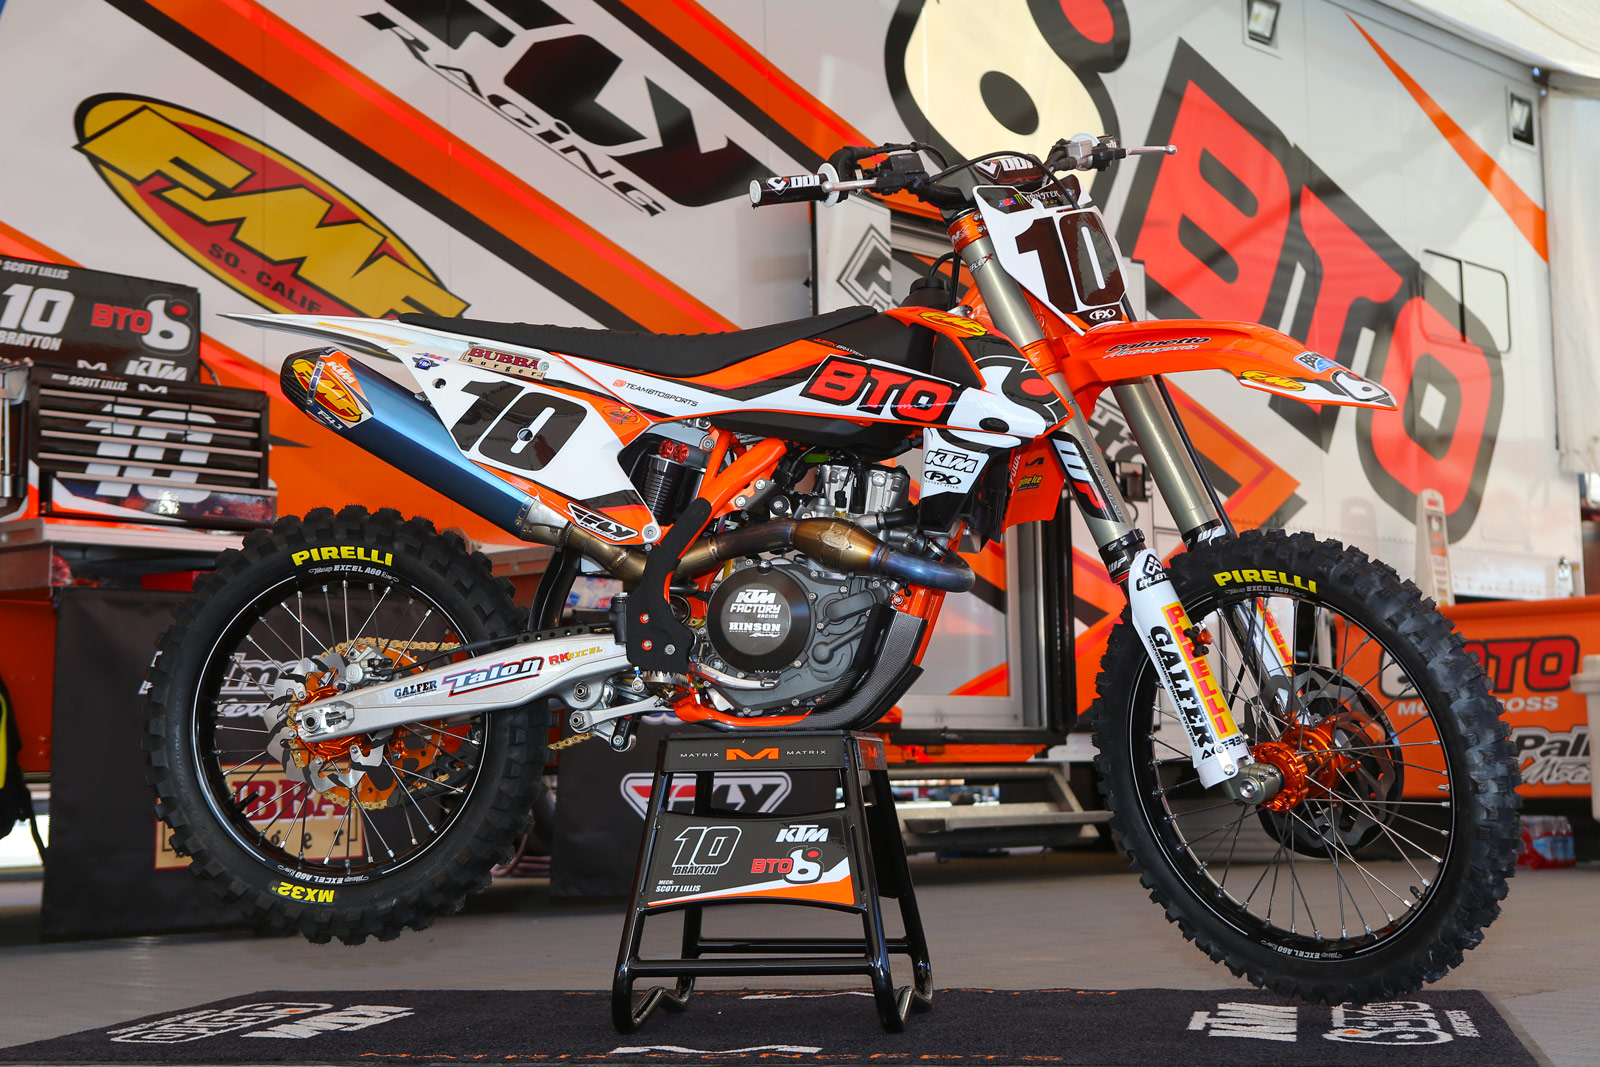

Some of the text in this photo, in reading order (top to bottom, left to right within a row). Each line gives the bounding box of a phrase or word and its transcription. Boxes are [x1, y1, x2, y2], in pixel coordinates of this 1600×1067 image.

[359, 12, 666, 217] RACING
[3, 260, 70, 280] SCOTT LILLIS
[1018, 211, 1127, 314] 10
[1, 283, 75, 335] 10
[91, 303, 152, 334] BTO
[1090, 307, 1116, 320] FX
[921, 311, 987, 335] FMF
[125, 356, 187, 381] KTM
[467, 357, 538, 376] burger
[468, 348, 539, 370] BUBBA
[69, 375, 100, 388] SCOTT
[100, 379, 128, 391] LILLIS
[327, 361, 356, 384] KTM
[1242, 371, 1305, 391] FMF
[802, 358, 958, 424] BTO
[450, 380, 588, 471] 10
[924, 448, 979, 473] KTM
[924, 470, 962, 485] FX
[569, 504, 637, 538] FLY
[291, 546, 393, 567] PIRELLI
[334, 564, 364, 572] EXCEL
[1213, 569, 1317, 594] PIRELLI
[735, 589, 776, 604] KTM
[729, 603, 782, 614] FACTORY
[729, 622, 781, 632] HINSON
[549, 646, 603, 664] RK EXCEL
[442, 656, 545, 698] Talon
[1166, 605, 1227, 734] PIRELLI
[394, 680, 437, 698] GALFER
[1150, 625, 1214, 748] GALFER
[775, 824, 829, 843] KTM
[671, 826, 743, 868] 10
[672, 865, 720, 876] BRAYTON
[750, 858, 794, 874] BTO
[655, 884, 701, 893] SCOTT LILLIS
